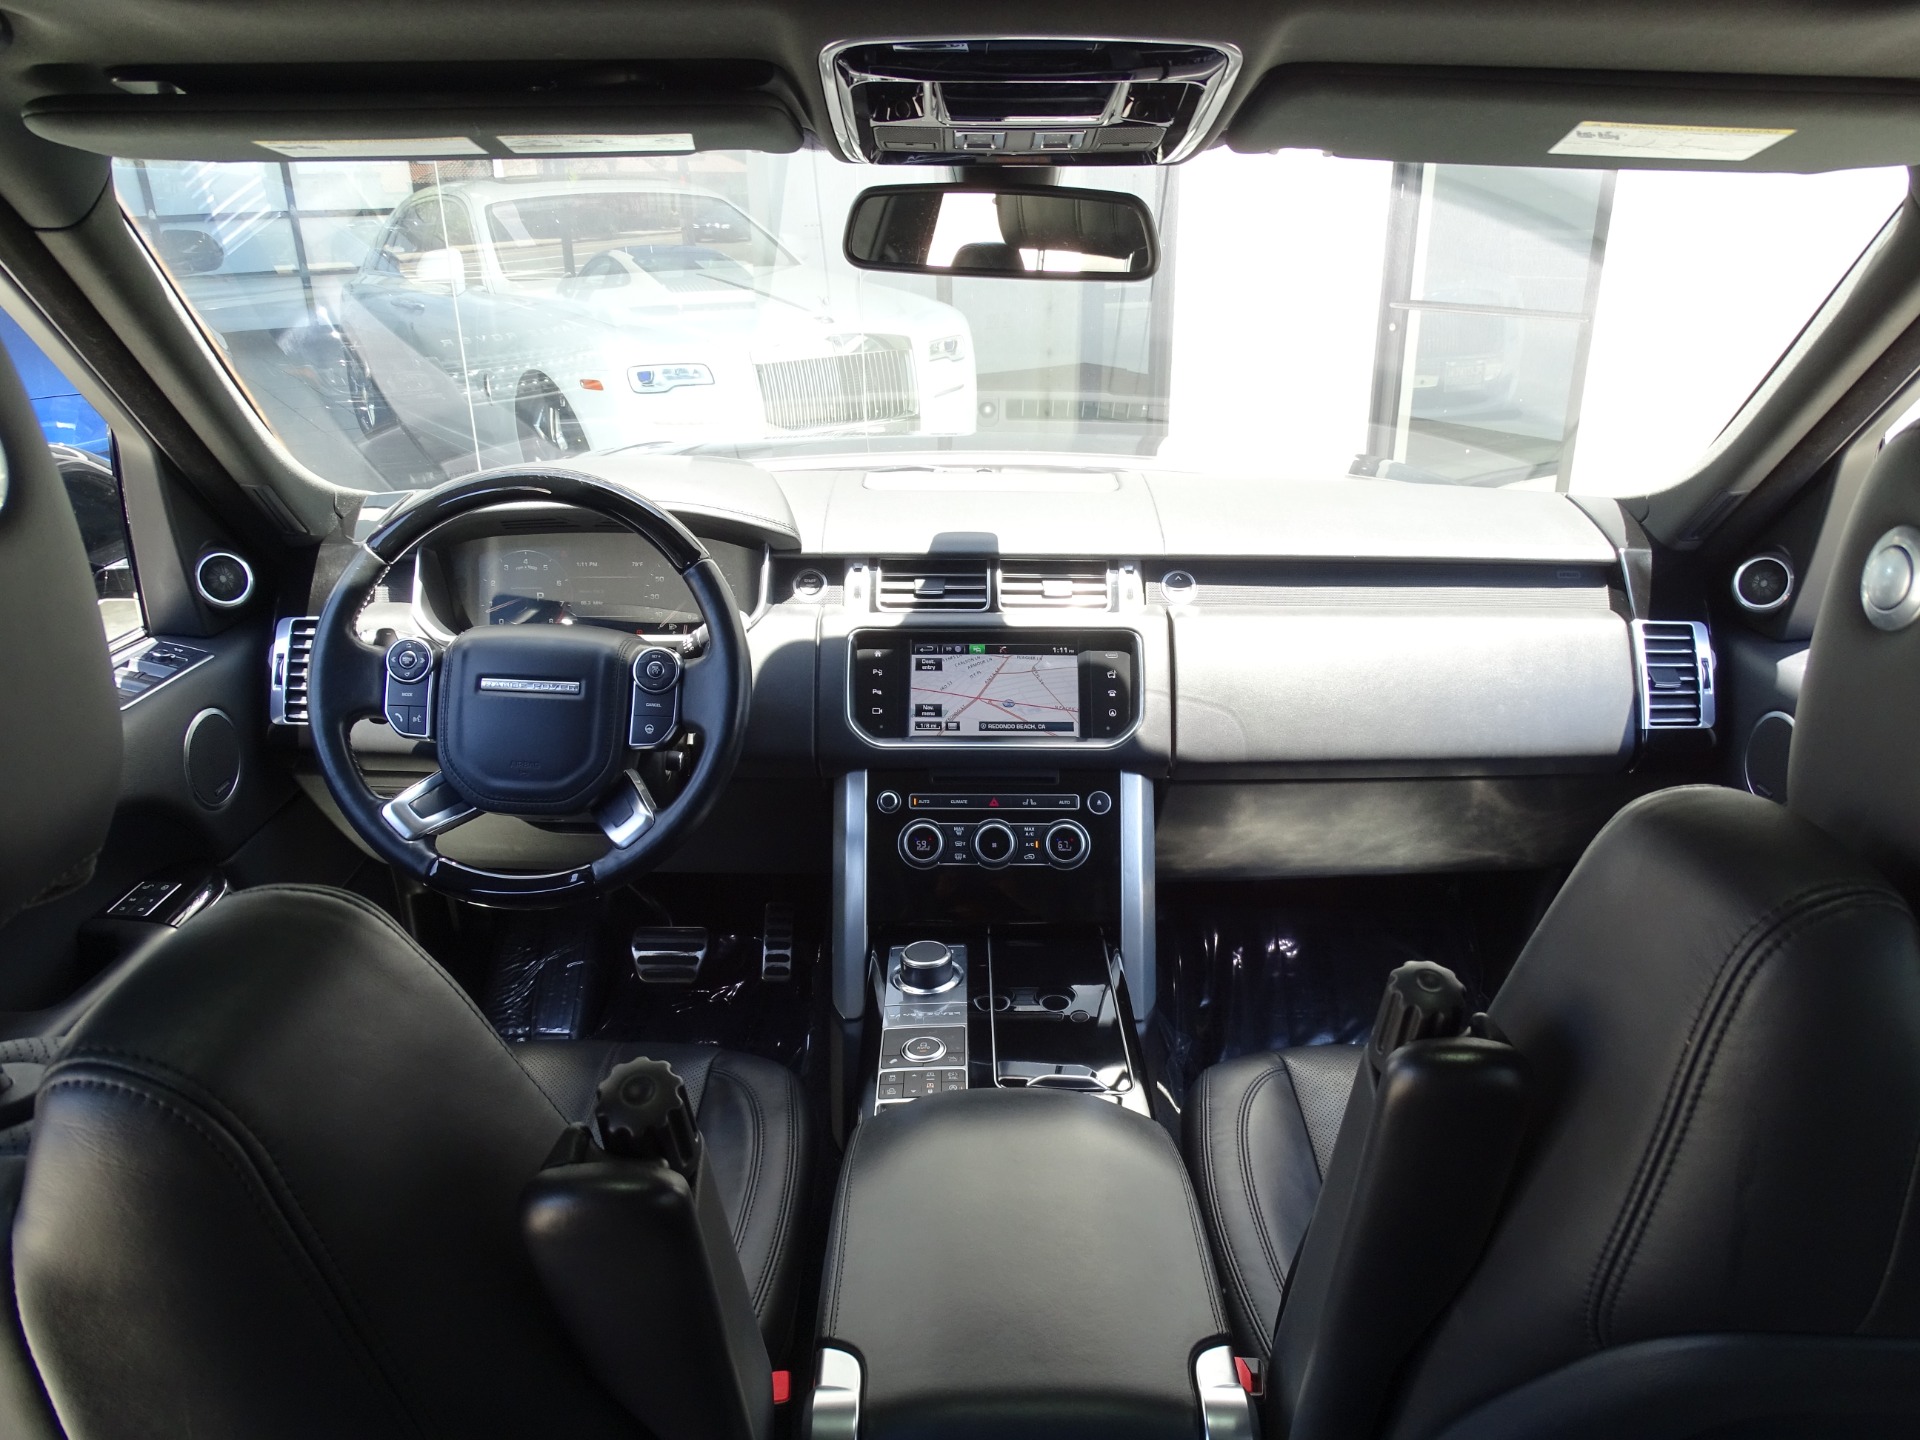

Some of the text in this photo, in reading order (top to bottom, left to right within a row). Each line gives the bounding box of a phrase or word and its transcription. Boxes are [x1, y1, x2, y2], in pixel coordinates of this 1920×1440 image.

[536, 592, 545, 602] P
[483, 681, 579, 691] RANGE ROVER
